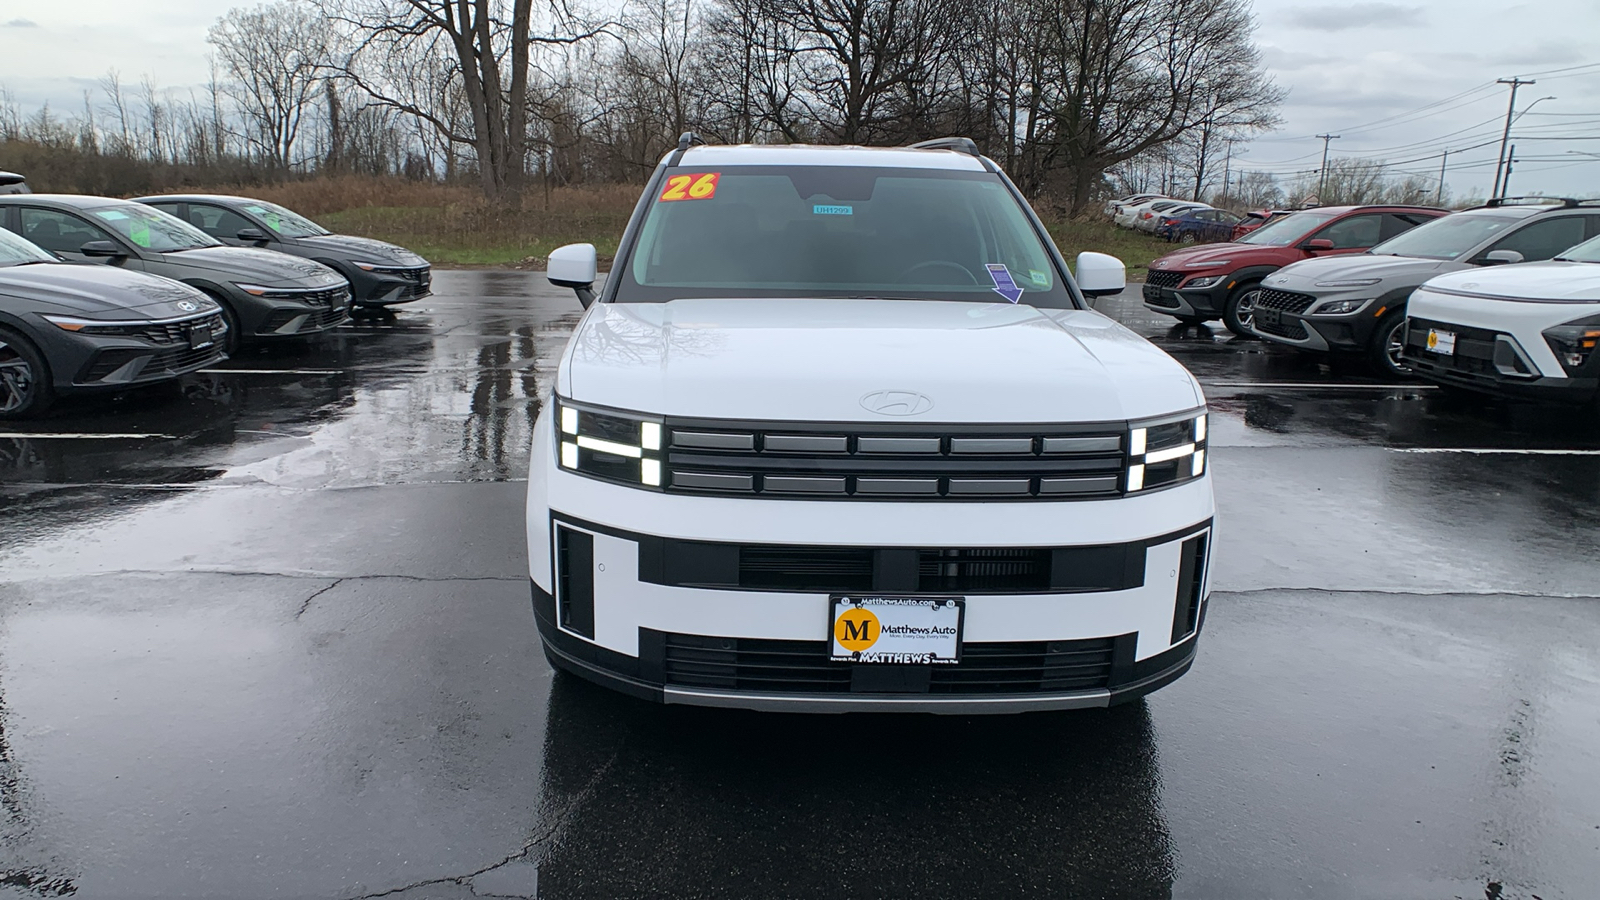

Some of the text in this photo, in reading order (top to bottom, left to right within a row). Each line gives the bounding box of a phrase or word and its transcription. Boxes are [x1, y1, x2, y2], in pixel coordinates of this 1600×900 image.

[661, 174, 716, 200] 26
[861, 598, 936, 607] MatthewsAuto.com
[841, 620, 872, 641] M
[881, 625, 957, 635] Matthews Auto
[859, 653, 931, 664] MATTHEWS
